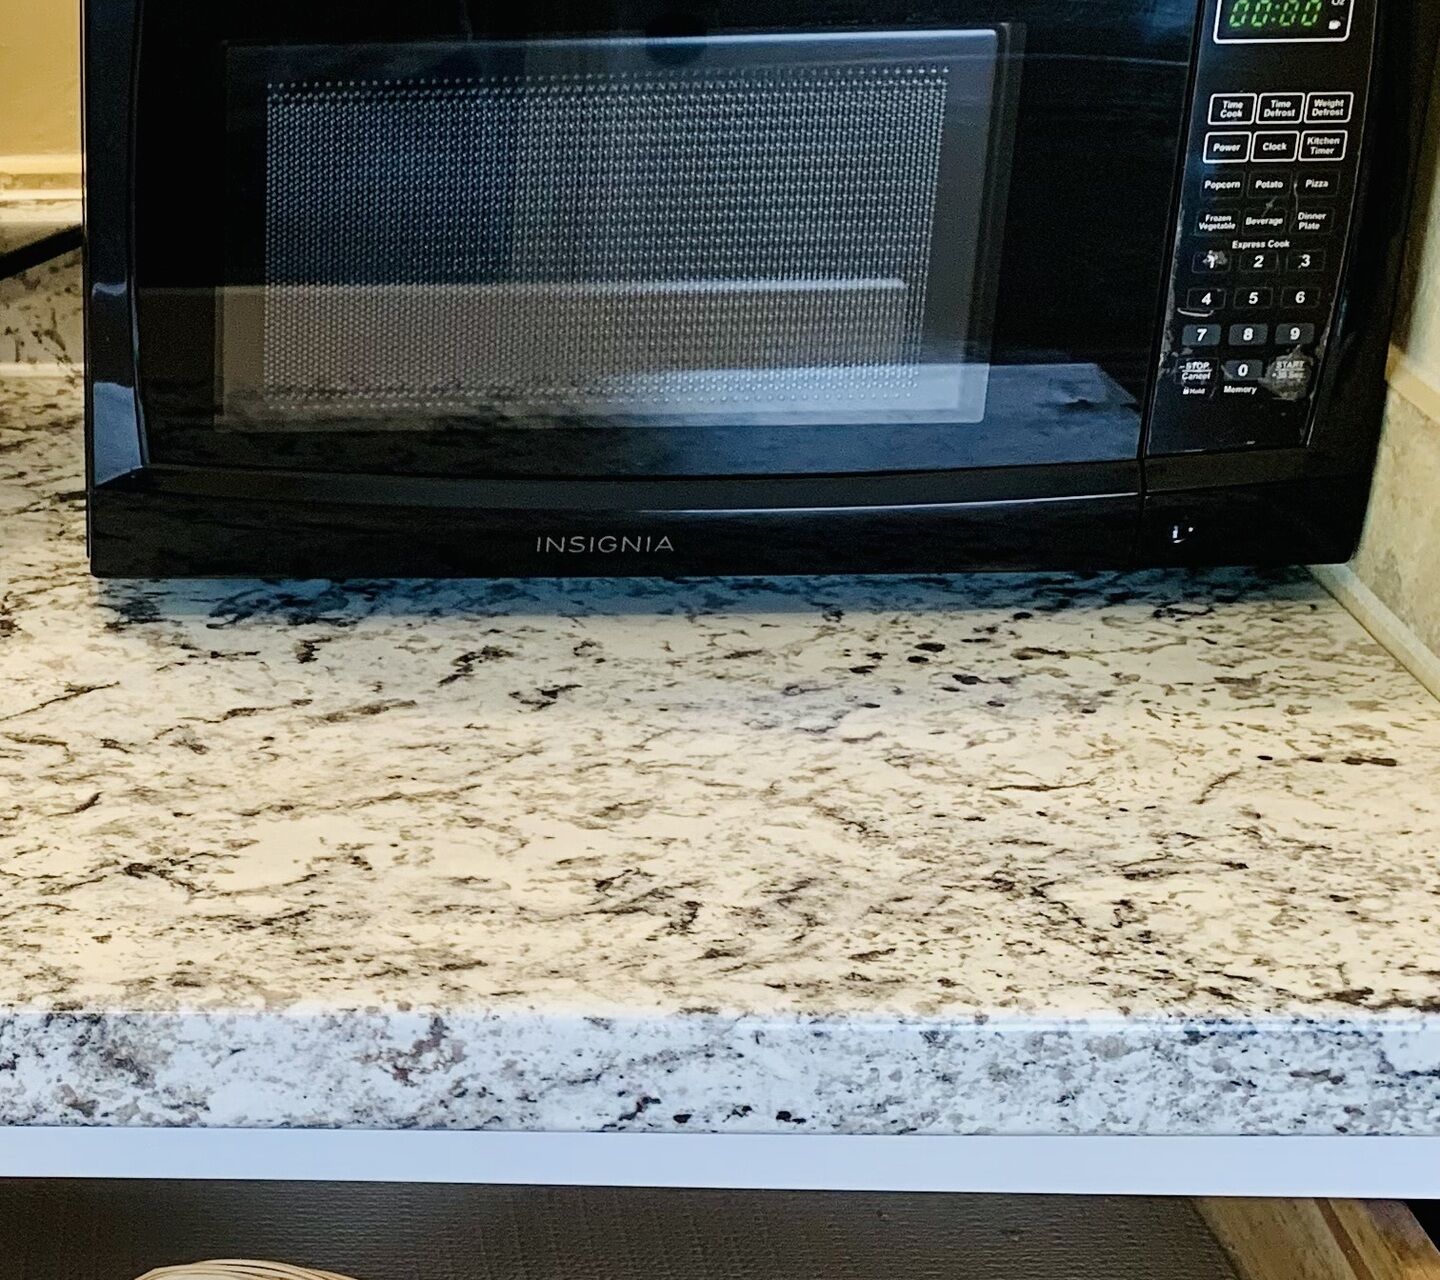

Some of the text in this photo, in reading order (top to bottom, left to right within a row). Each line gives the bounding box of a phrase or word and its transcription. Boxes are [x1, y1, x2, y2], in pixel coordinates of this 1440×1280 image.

[1229, 0, 1322, 27] 00:00
[1223, 100, 1243, 109] Time
[1271, 99, 1291, 108] Time
[1314, 99, 1344, 108] Weight
[1220, 109, 1243, 118] Cook
[1264, 108, 1295, 117] Defrost
[1312, 108, 1344, 117] Defrost
[1307, 136, 1340, 145] Kitchen
[1213, 143, 1241, 152] Power
[1263, 142, 1287, 152] Clock
[1310, 146, 1334, 155] Timer
[1204, 180, 1241, 190] Popcorn
[1255, 180, 1284, 189] Potato
[1305, 179, 1329, 188] Pizza
[1205, 214, 1232, 222] Frozen
[1298, 212, 1327, 221] Dinner
[1199, 222, 1236, 230] Vegetable
[1245, 217, 1283, 227] Beverage
[1299, 221, 1320, 230] Plate
[1232, 239, 1290, 250] Express Cook
[1253, 255, 1264, 268] 2
[1301, 254, 1311, 267] 3
[1201, 292, 1211, 305] 4
[1249, 292, 1259, 304] 5
[1295, 291, 1305, 303] 6
[1197, 329, 1207, 341] 7
[1243, 328, 1254, 340] 8
[1290, 327, 1300, 340] 9
[1186, 362, 1210, 370] STOP
[1238, 364, 1248, 376] 0
[1182, 372, 1210, 380] Cancel
[1224, 386, 1257, 395] Memory
[536, 536, 674, 553] INSIGNIA
